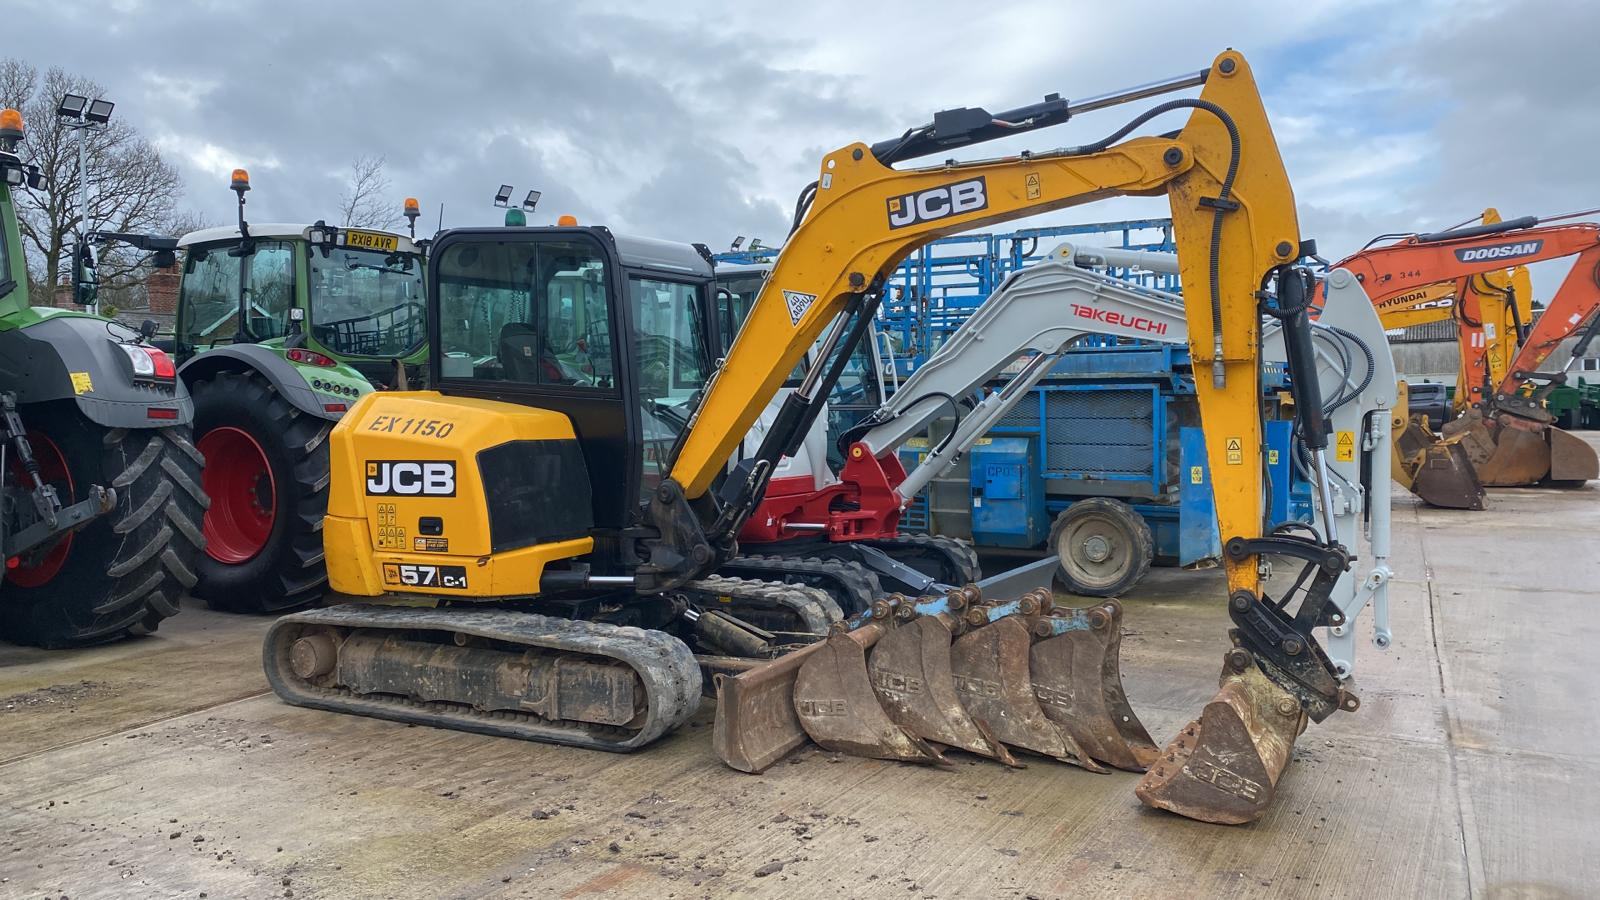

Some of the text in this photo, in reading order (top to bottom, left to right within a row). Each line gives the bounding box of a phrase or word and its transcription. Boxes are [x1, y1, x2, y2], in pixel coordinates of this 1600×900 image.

[890, 180, 986, 226] JCB
[351, 233, 372, 247] RX18
[374, 236, 392, 249] AVR
[1462, 242, 1538, 262] DOOSAN
[1400, 270, 1421, 279] 344
[1379, 291, 1427, 309] HYUNDAI
[368, 415, 454, 439] EX 1150
[367, 462, 454, 494] JCB
[400, 565, 436, 585] 57
[443, 575, 467, 588] C-1
